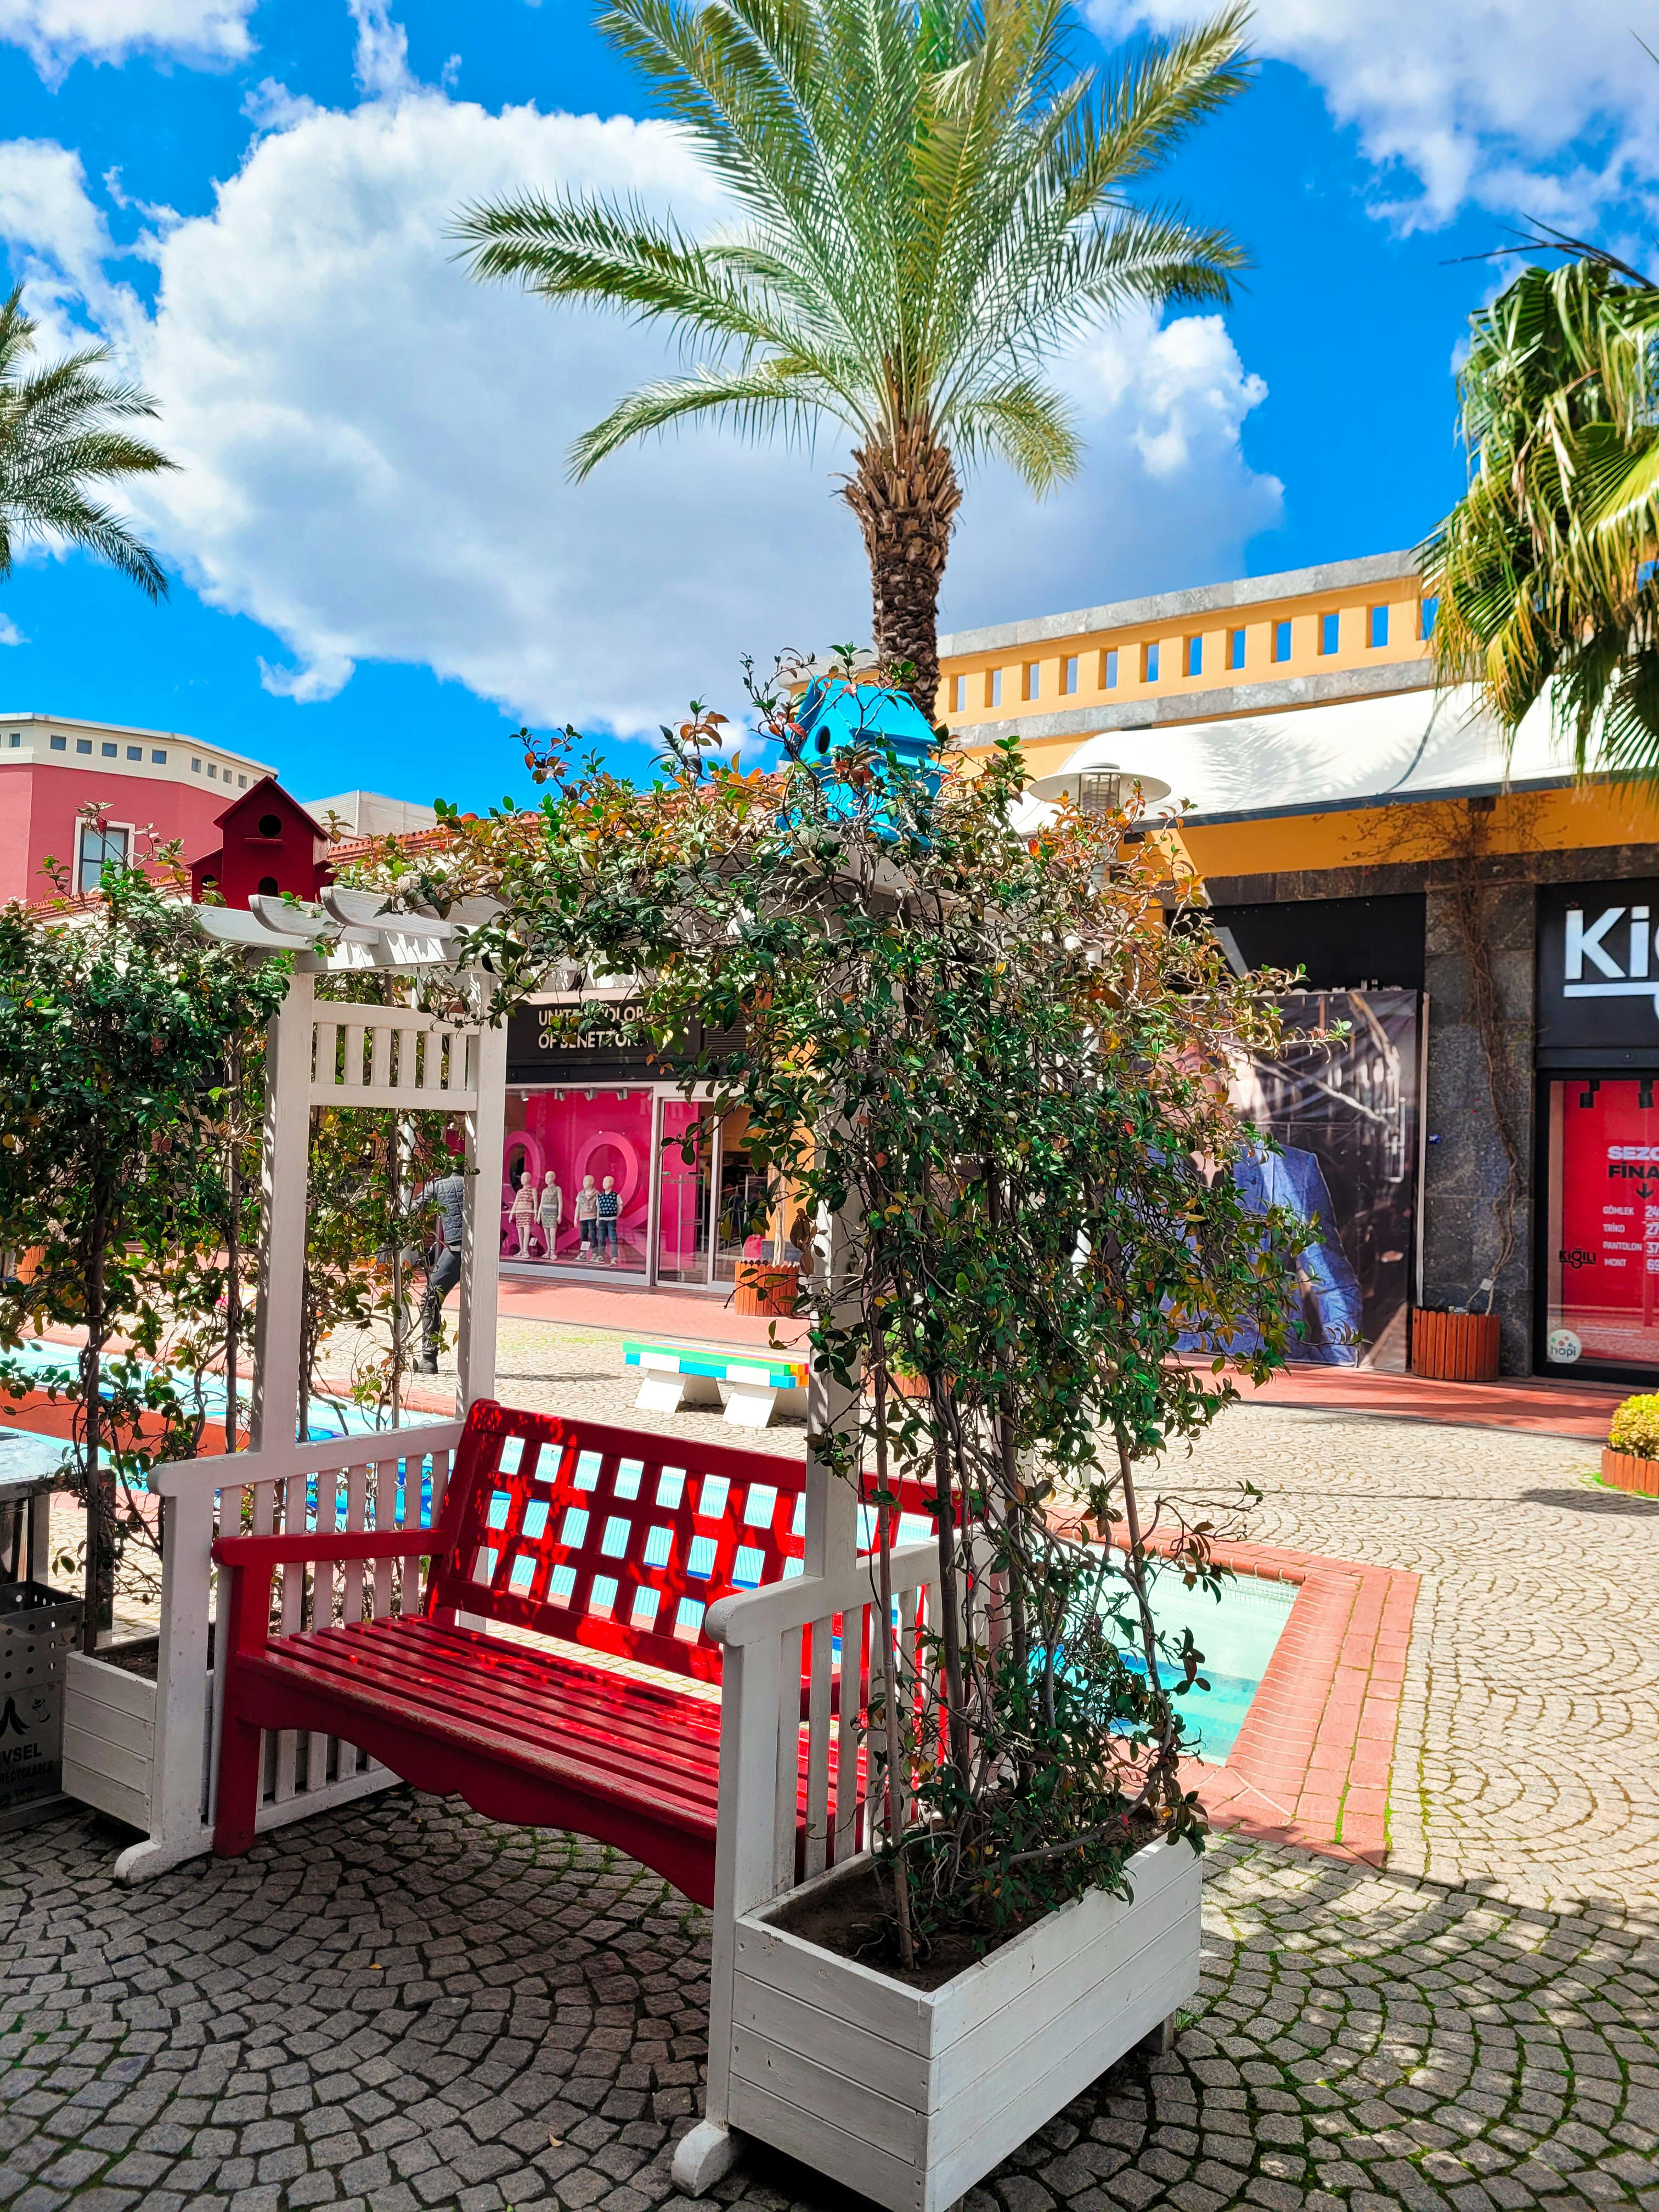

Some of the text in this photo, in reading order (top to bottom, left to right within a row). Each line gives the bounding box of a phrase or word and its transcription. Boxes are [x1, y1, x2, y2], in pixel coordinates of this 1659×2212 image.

[1564, 906, 1659, 998] Ki
[539, 1031, 557, 1049] OF
[1550, 1346, 1576, 1358] hopi
[0, 1742, 42, 1765] VSEL
